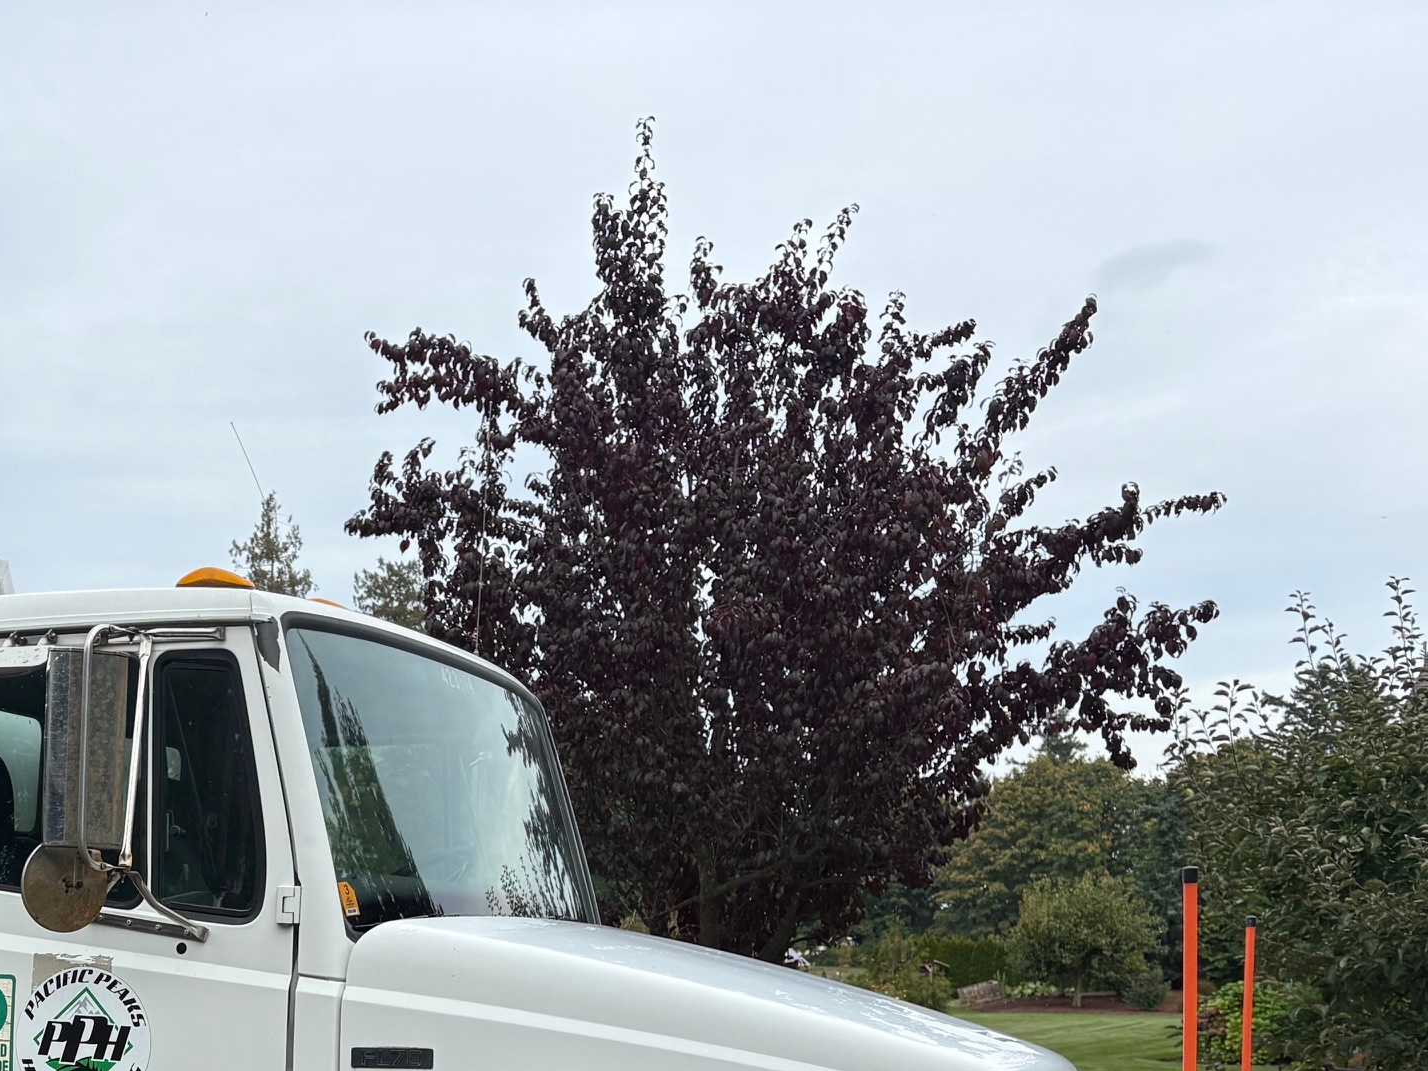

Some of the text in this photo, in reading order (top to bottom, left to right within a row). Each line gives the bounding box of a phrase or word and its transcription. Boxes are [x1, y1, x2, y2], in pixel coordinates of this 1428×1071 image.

[343, 884, 350, 895] 3
[24, 969, 147, 1028] PACIFIC PEAKS
[38, 1014, 132, 1063] PPH
[360, 1048, 423, 1067] FL70
